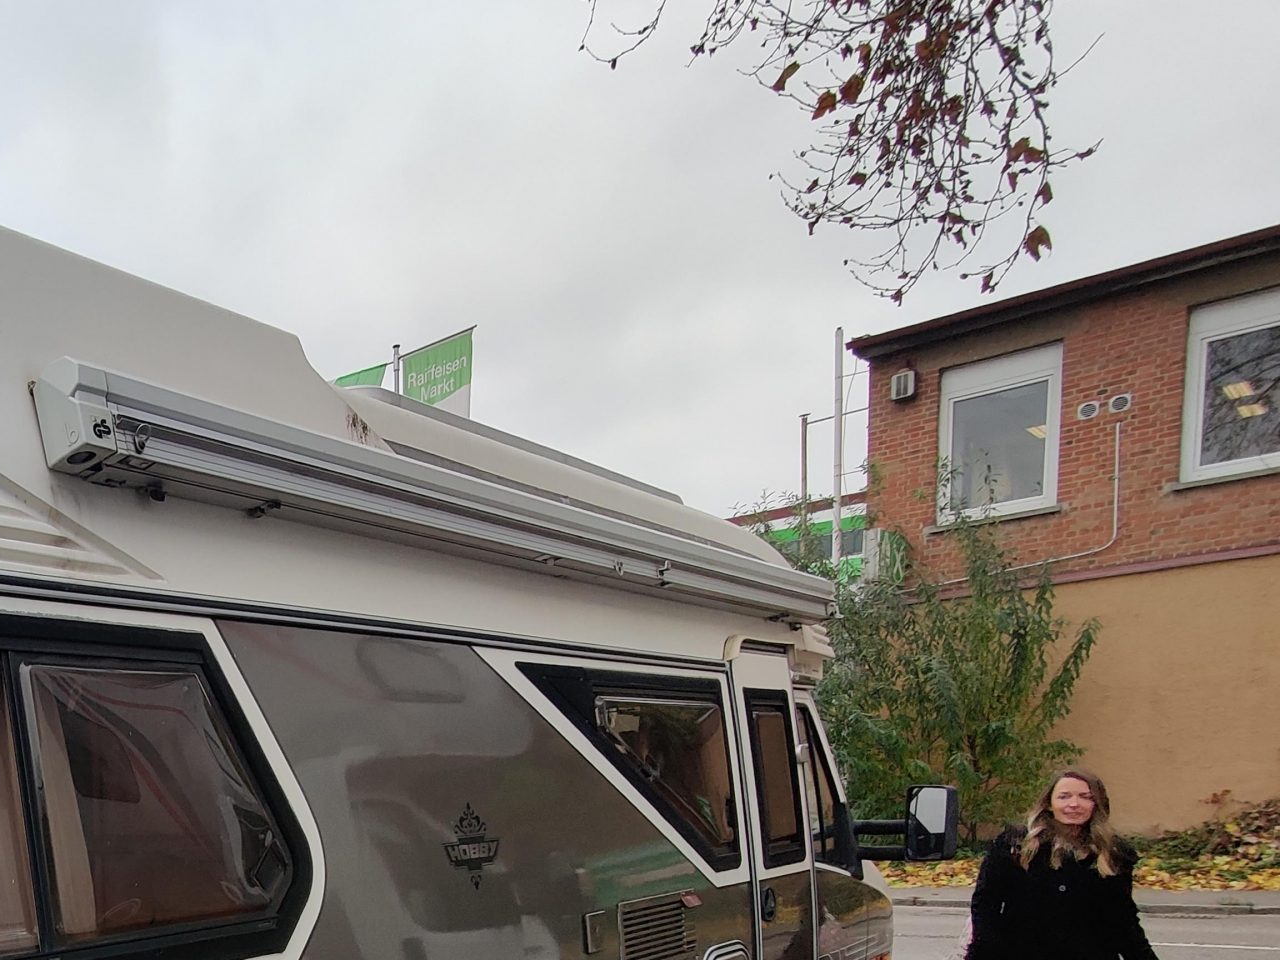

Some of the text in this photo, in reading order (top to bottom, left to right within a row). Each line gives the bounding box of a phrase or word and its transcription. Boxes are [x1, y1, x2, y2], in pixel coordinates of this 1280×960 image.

[407, 355, 467, 389] Raiffeisen
[420, 378, 455, 402] Markt
[446, 841, 498, 861] HOBBY
